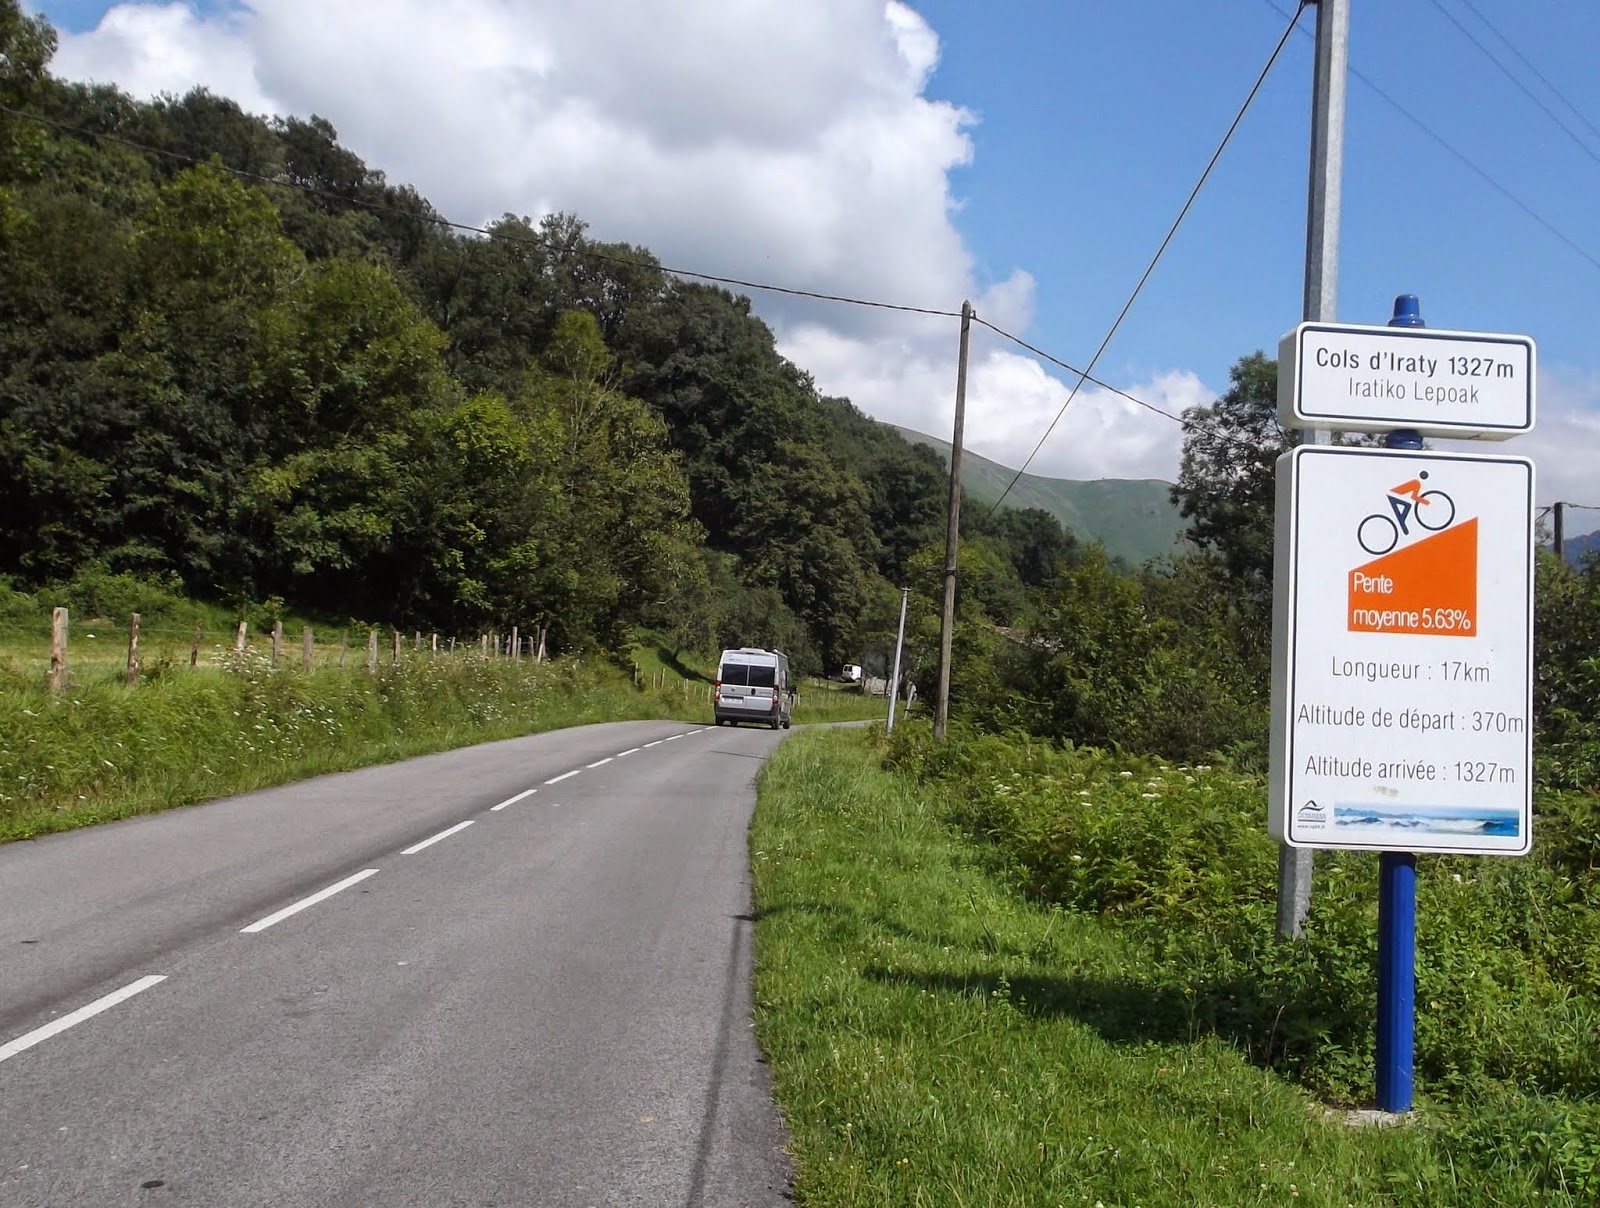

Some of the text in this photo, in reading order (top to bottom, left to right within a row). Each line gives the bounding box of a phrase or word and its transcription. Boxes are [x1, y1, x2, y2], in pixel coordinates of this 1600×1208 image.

[1316, 347, 1514, 378] Cols d'Iraty 1327m
[1349, 377, 1479, 405] Iratiko Lepoak
[1353, 571, 1394, 594] Pente
[1353, 608, 1471, 630] moyenne 5.63%
[1332, 656, 1420, 682] Longueur
[1440, 661, 1490, 682] 17km
[1297, 704, 1365, 727] Altitude
[1371, 707, 1393, 728] de
[1400, 709, 1455, 733] départ
[1472, 711, 1524, 733] 370m
[1305, 755, 1372, 778] Altitude
[1378, 759, 1436, 781] arrivée
[1454, 761, 1515, 783] 1327m
